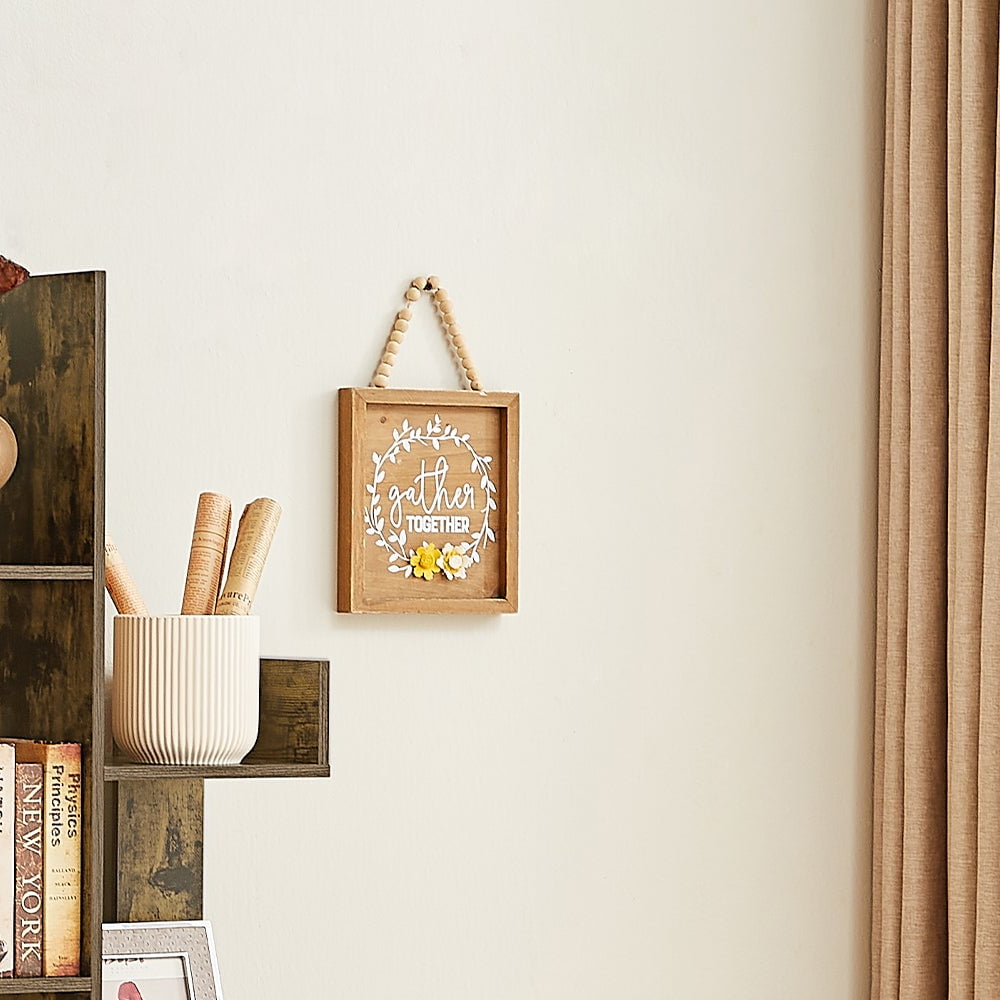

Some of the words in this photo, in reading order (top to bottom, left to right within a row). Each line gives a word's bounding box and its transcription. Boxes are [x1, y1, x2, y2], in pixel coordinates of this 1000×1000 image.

[388, 456, 476, 529] gather
[405, 515, 471, 534] TOGETHER
[21, 782, 42, 856] NEW
[48, 764, 65, 848] Principles
[65, 773, 81, 839] Physics
[20, 872, 42, 962] YORK
